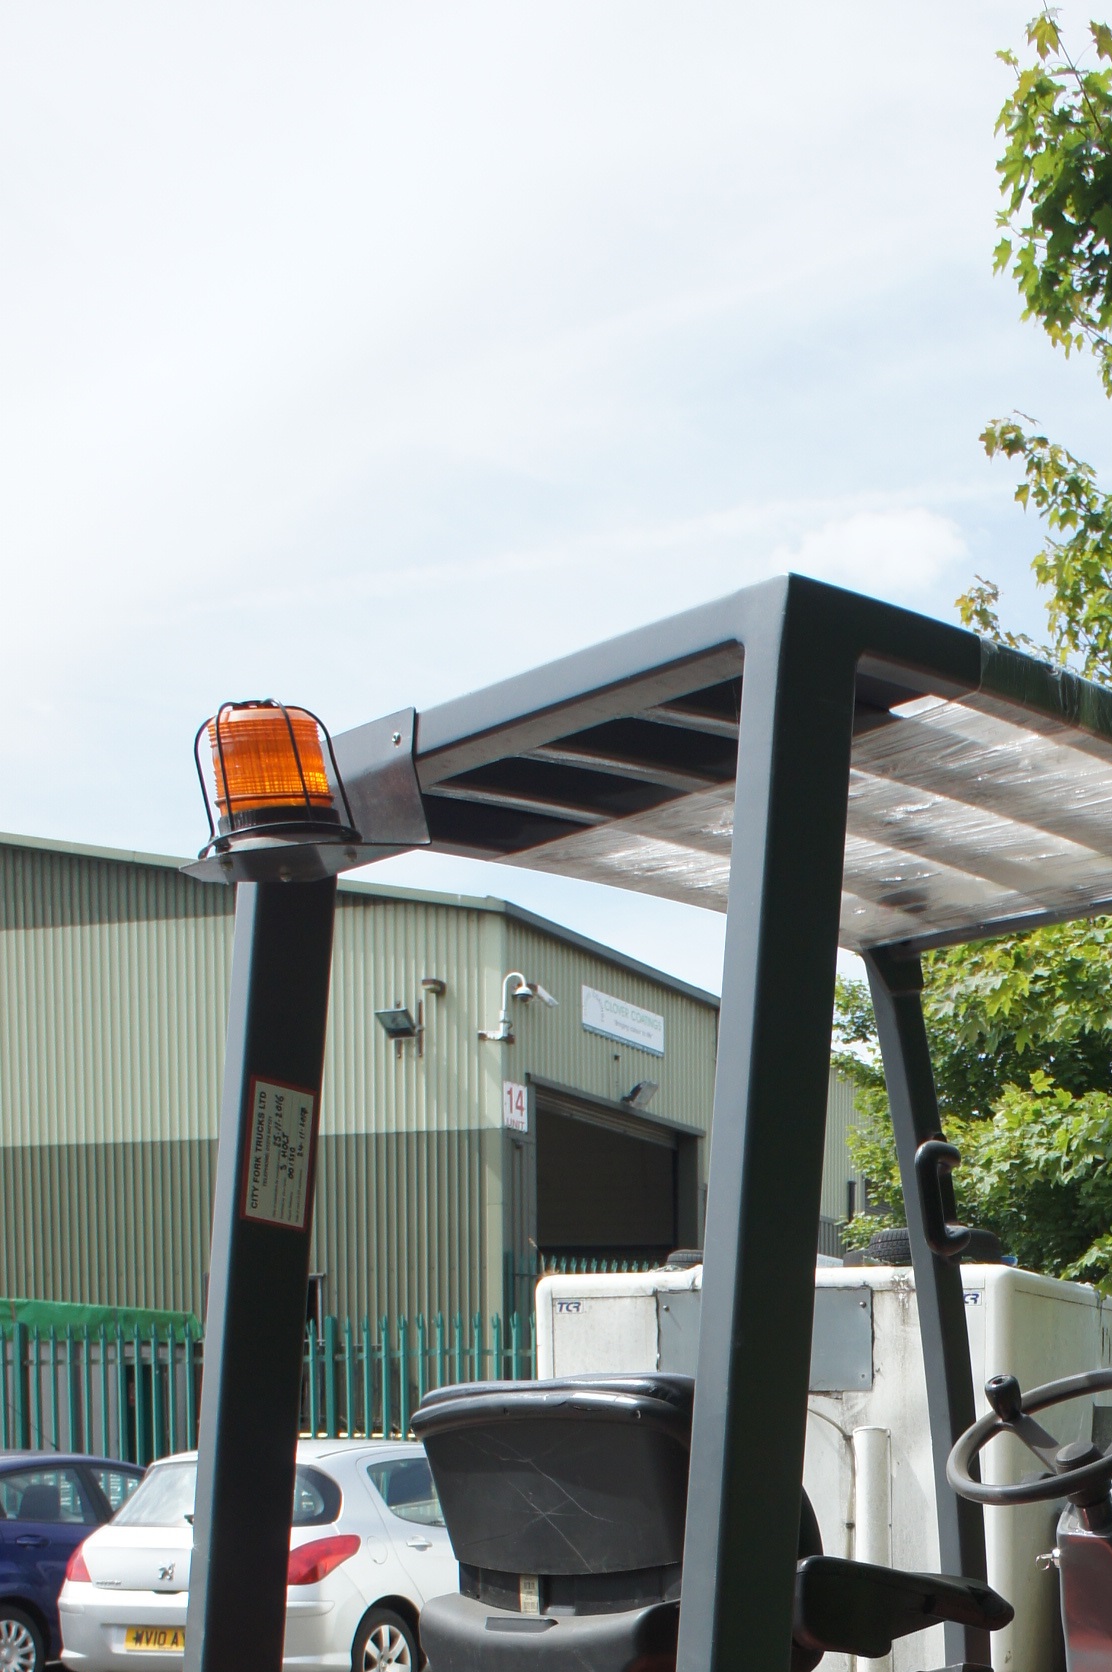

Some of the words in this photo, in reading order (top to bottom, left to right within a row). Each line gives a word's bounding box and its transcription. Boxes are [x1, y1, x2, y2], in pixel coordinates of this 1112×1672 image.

[259, 1091, 267, 1110] LTD
[507, 1087, 525, 1117] 14
[255, 1112, 266, 1156] TRUCKS
[253, 1156, 262, 1184] FORK
[251, 1186, 260, 1210] CITY
